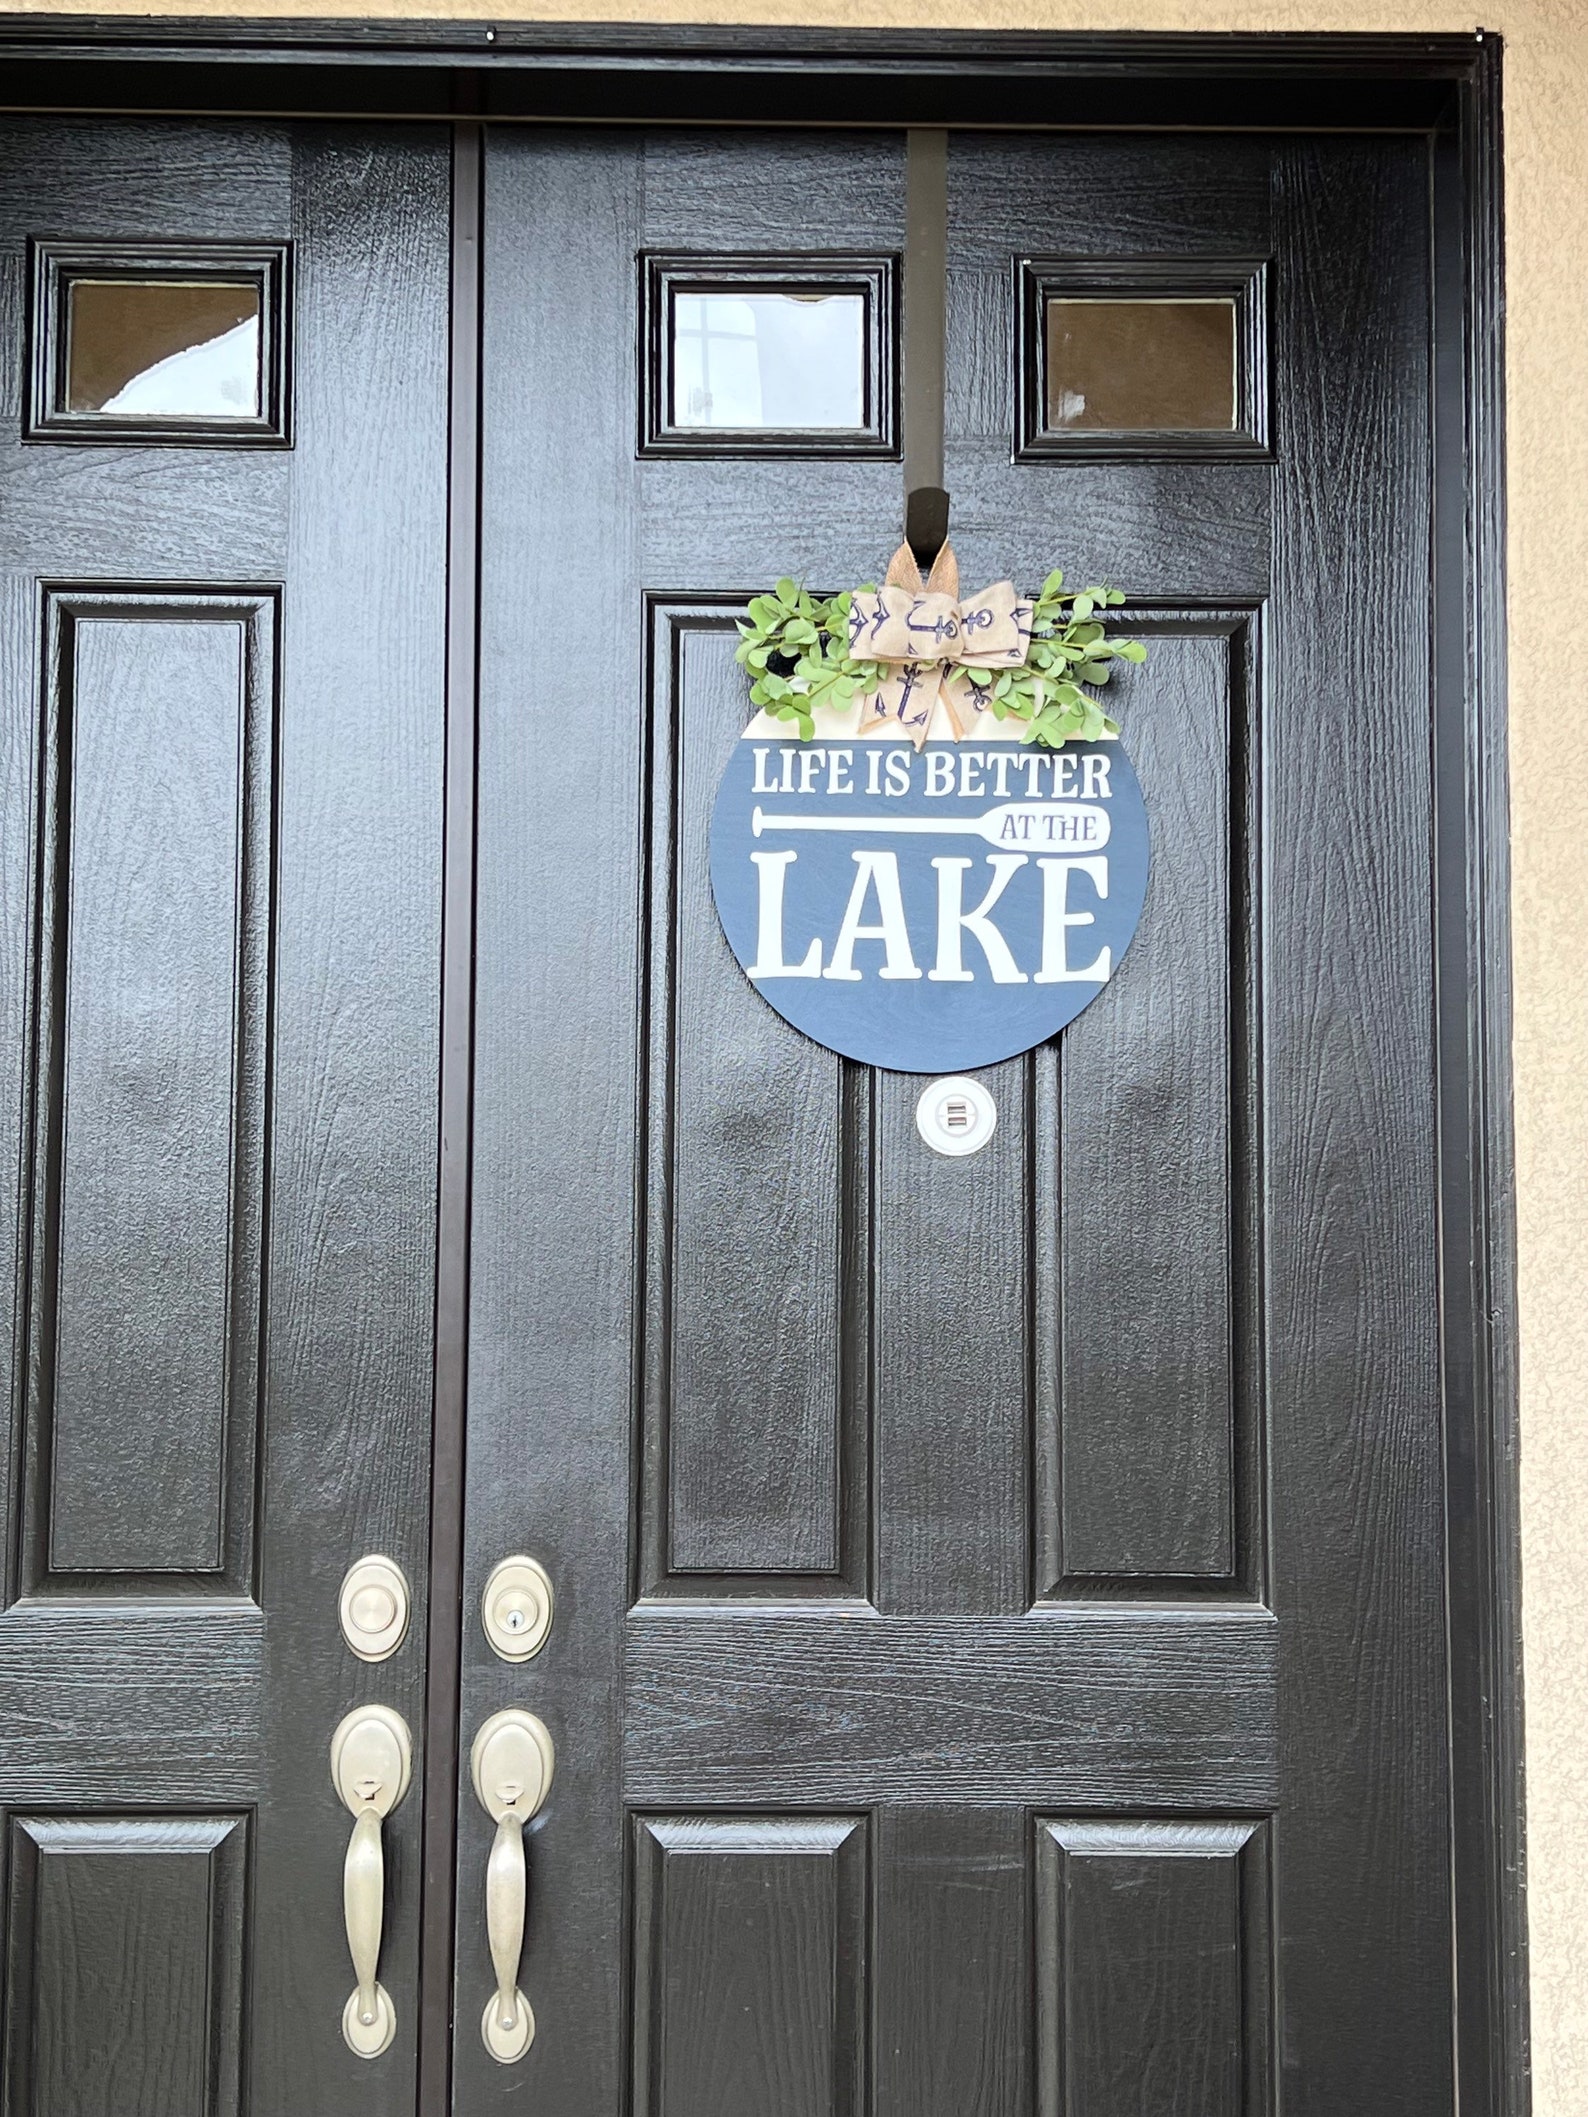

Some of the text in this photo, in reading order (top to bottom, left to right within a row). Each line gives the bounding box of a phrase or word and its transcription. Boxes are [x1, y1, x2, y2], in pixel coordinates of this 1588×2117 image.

[751, 748, 1112, 799] LIFE IS BETTER
[1000, 814, 1097, 842] AT THE
[747, 850, 1111, 984] LAKE
